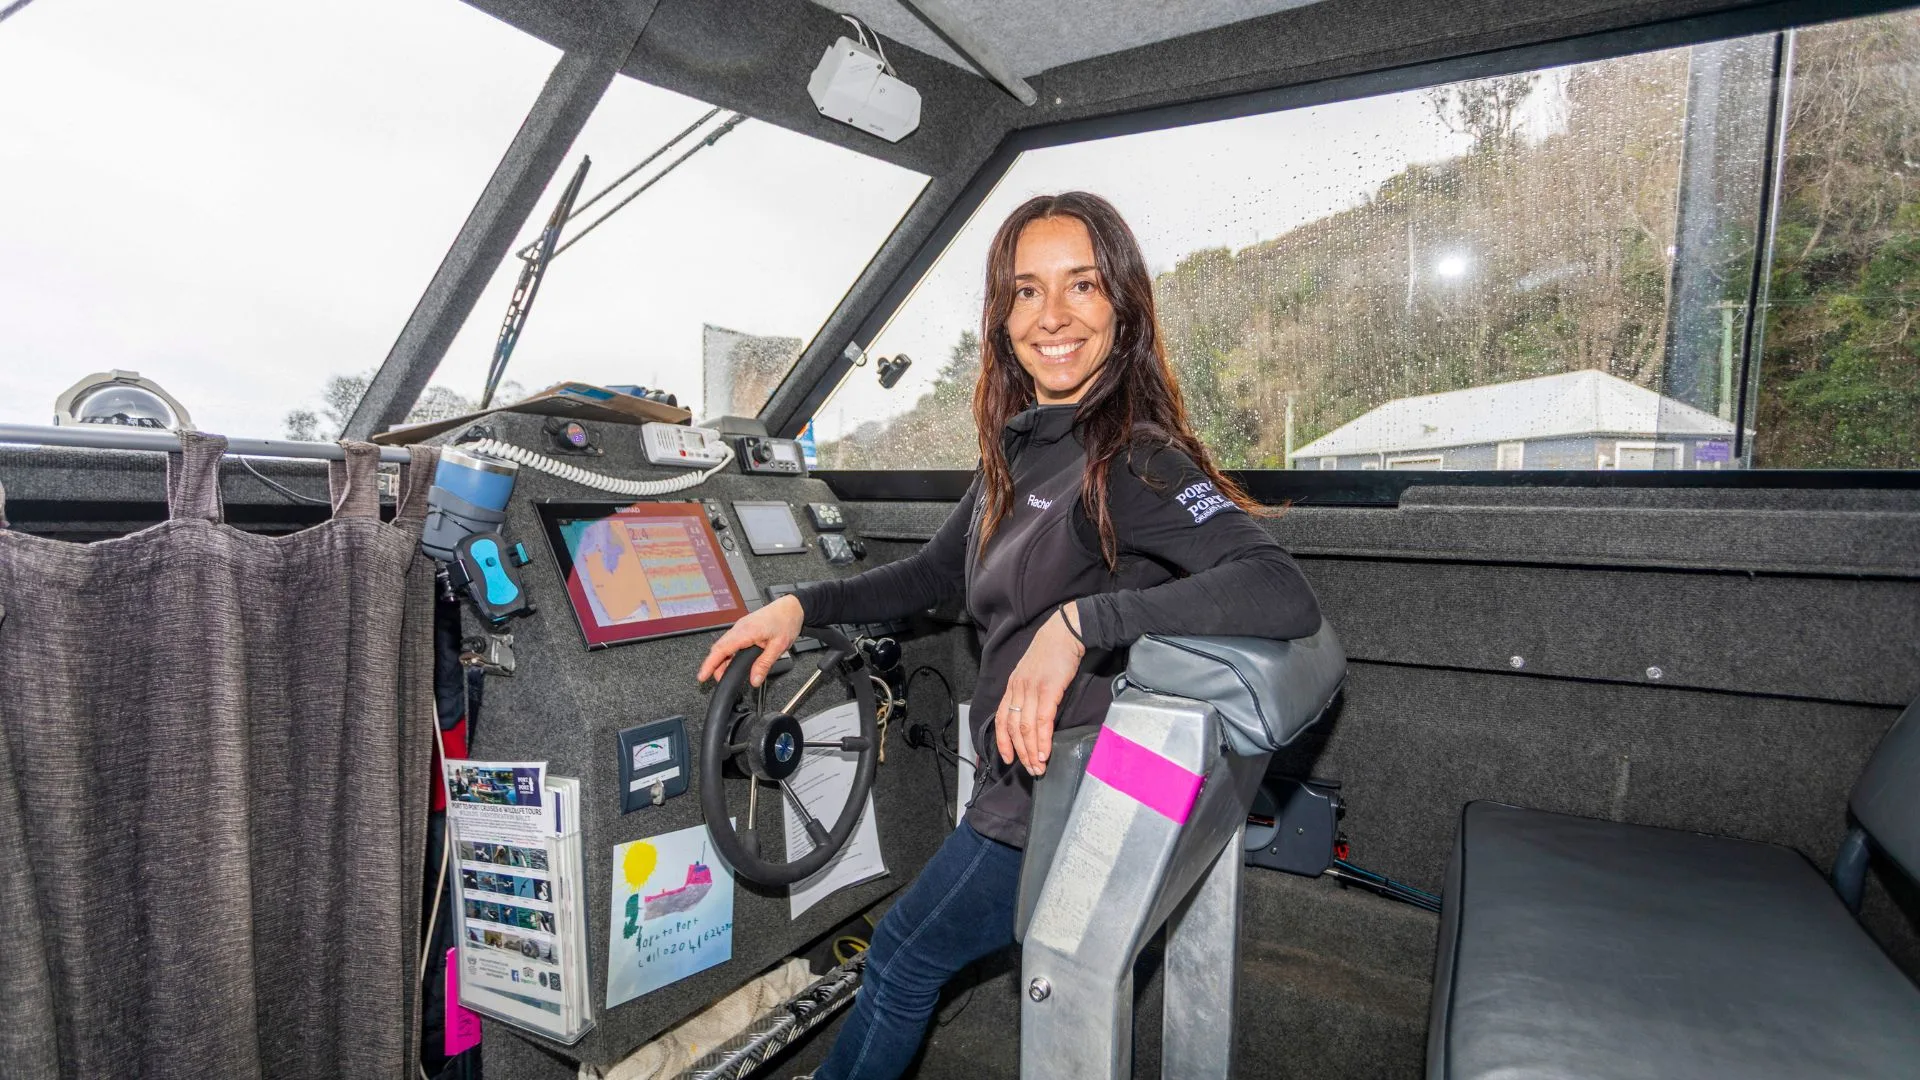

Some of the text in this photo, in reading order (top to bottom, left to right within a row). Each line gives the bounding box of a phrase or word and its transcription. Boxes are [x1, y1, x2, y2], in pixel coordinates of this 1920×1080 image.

[1027, 494, 1053, 510] Rachel
[1175, 481, 1212, 505] PORT
[1187, 495, 1225, 517] PORT
[526, 807, 542, 816] TOURS
